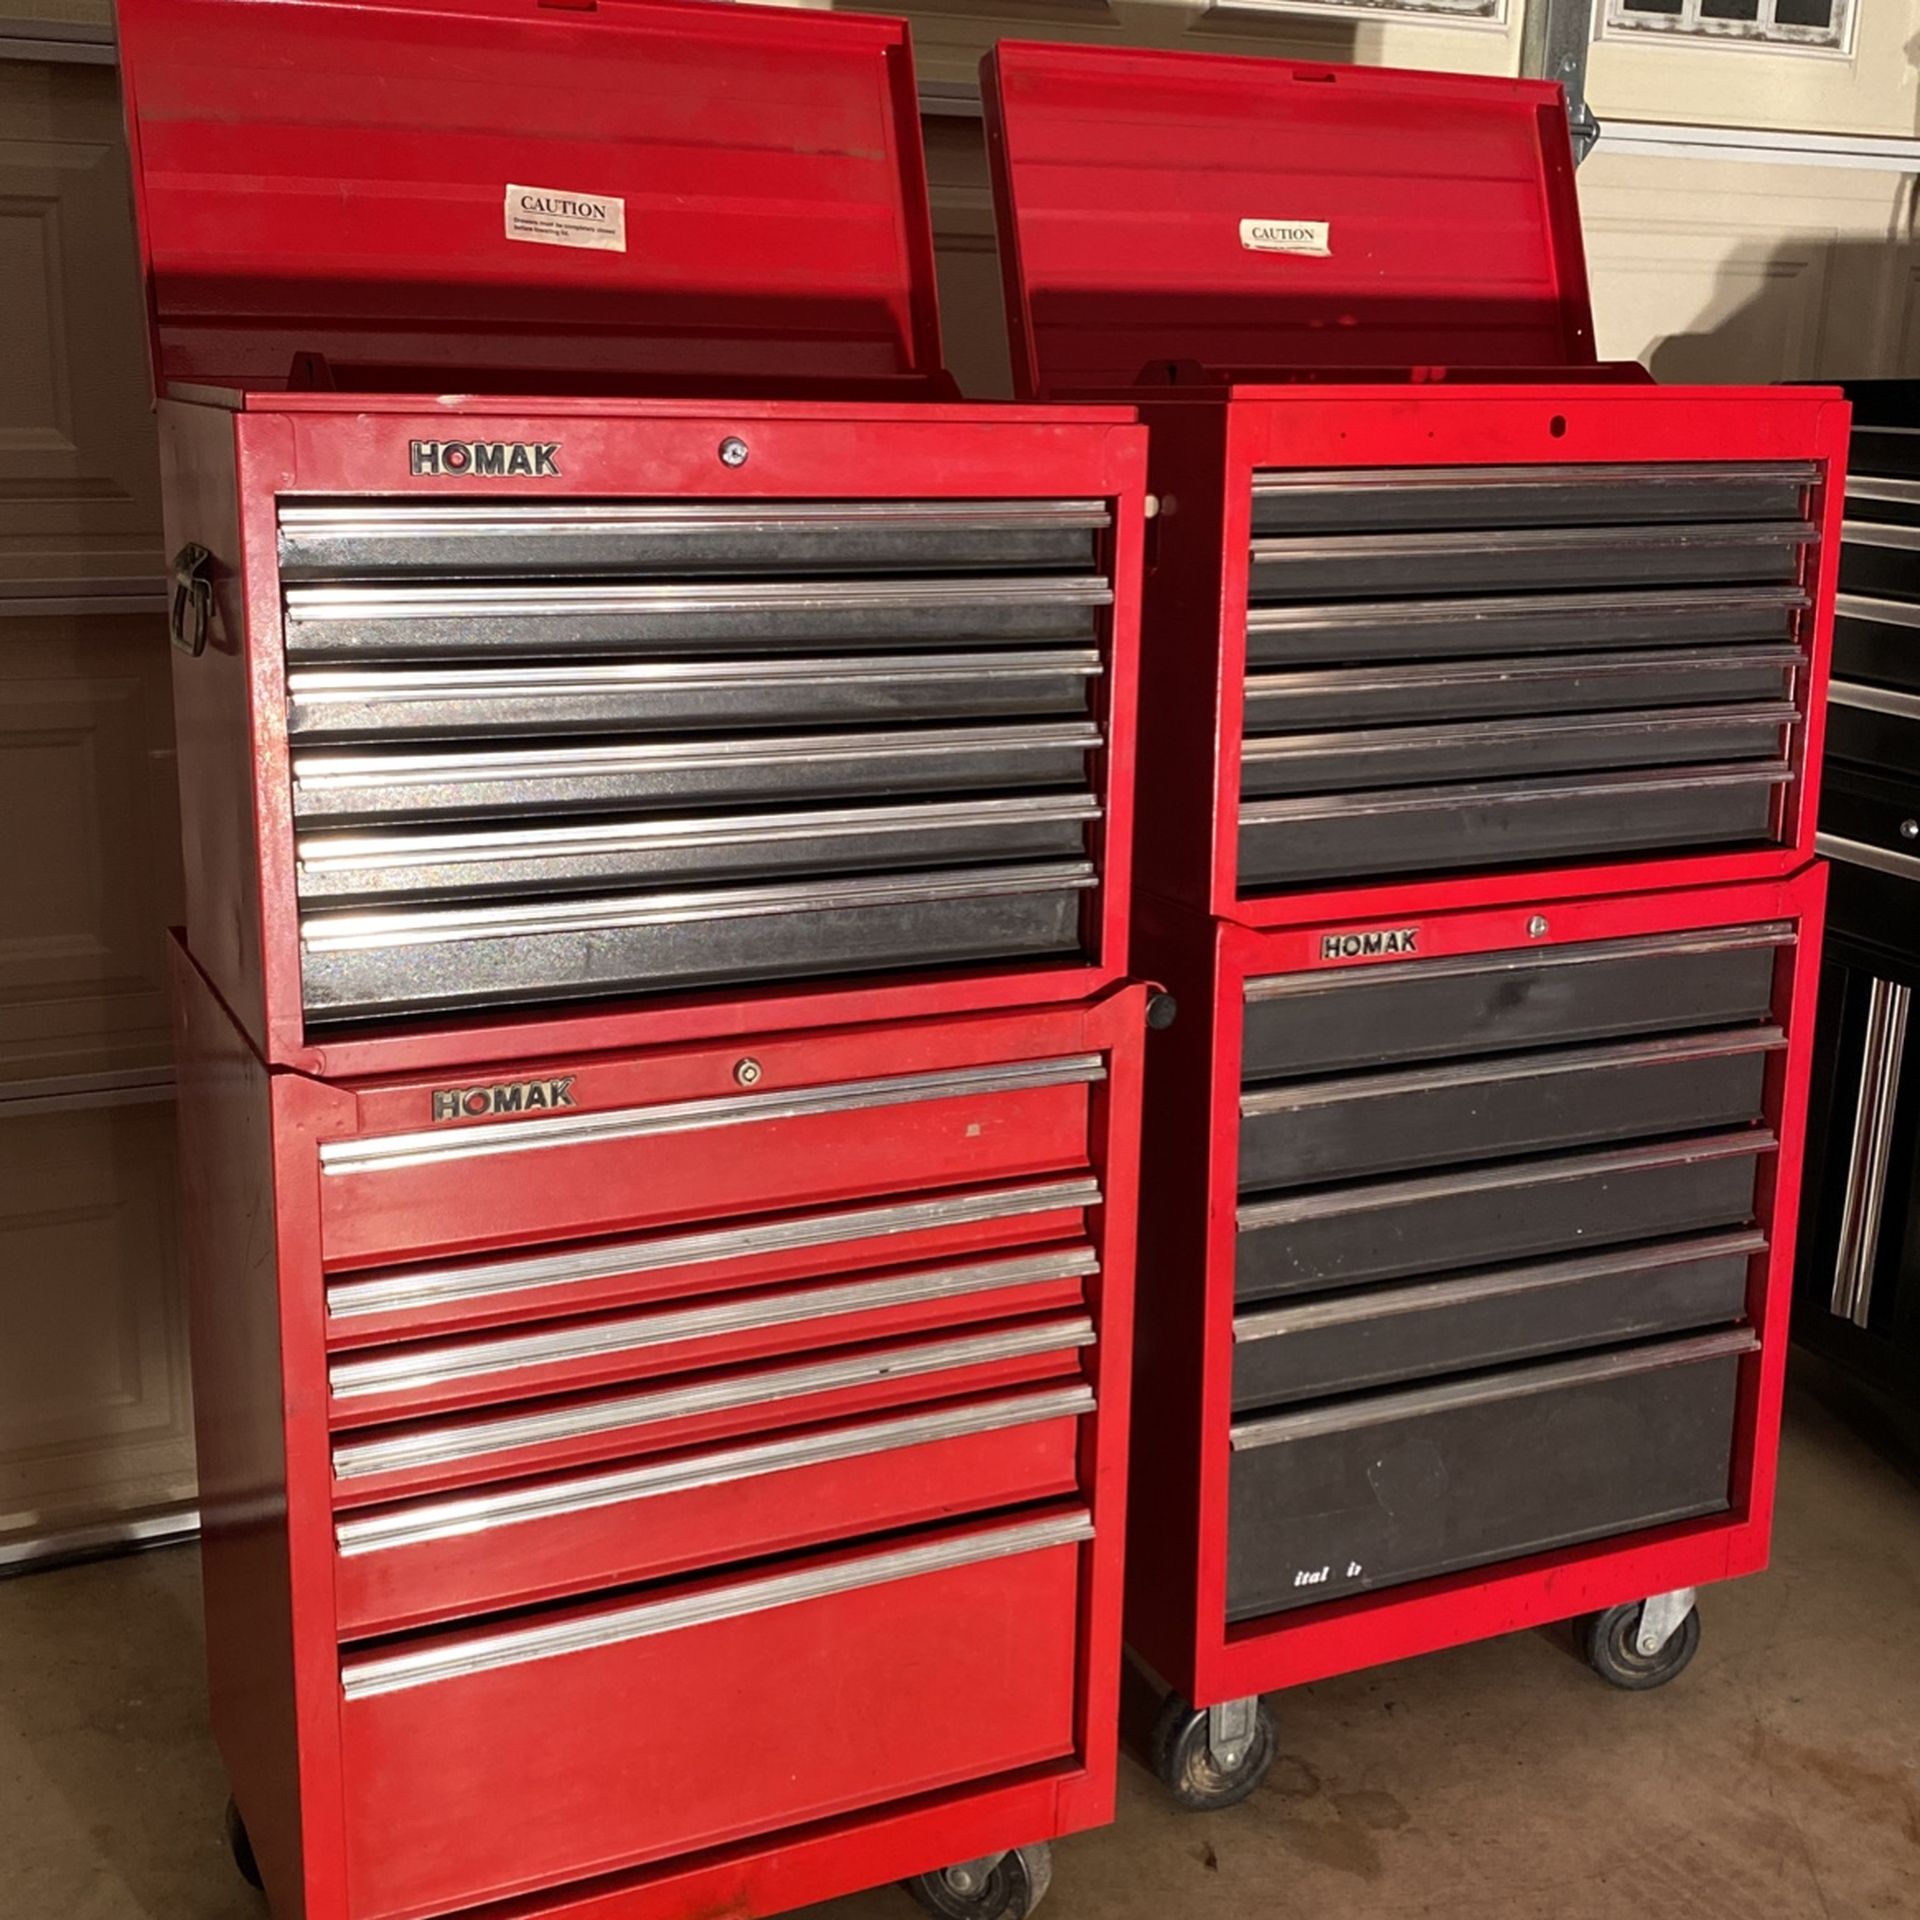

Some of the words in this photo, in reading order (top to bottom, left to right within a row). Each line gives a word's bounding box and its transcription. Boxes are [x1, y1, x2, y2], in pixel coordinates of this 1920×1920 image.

[521, 195, 606, 219] CAUTION
[1251, 226, 1315, 240] CAUTION
[410, 440, 562, 477] HOMAK
[1321, 928, 1419, 960] HOMAK
[433, 1074, 576, 1122] HOMAK
